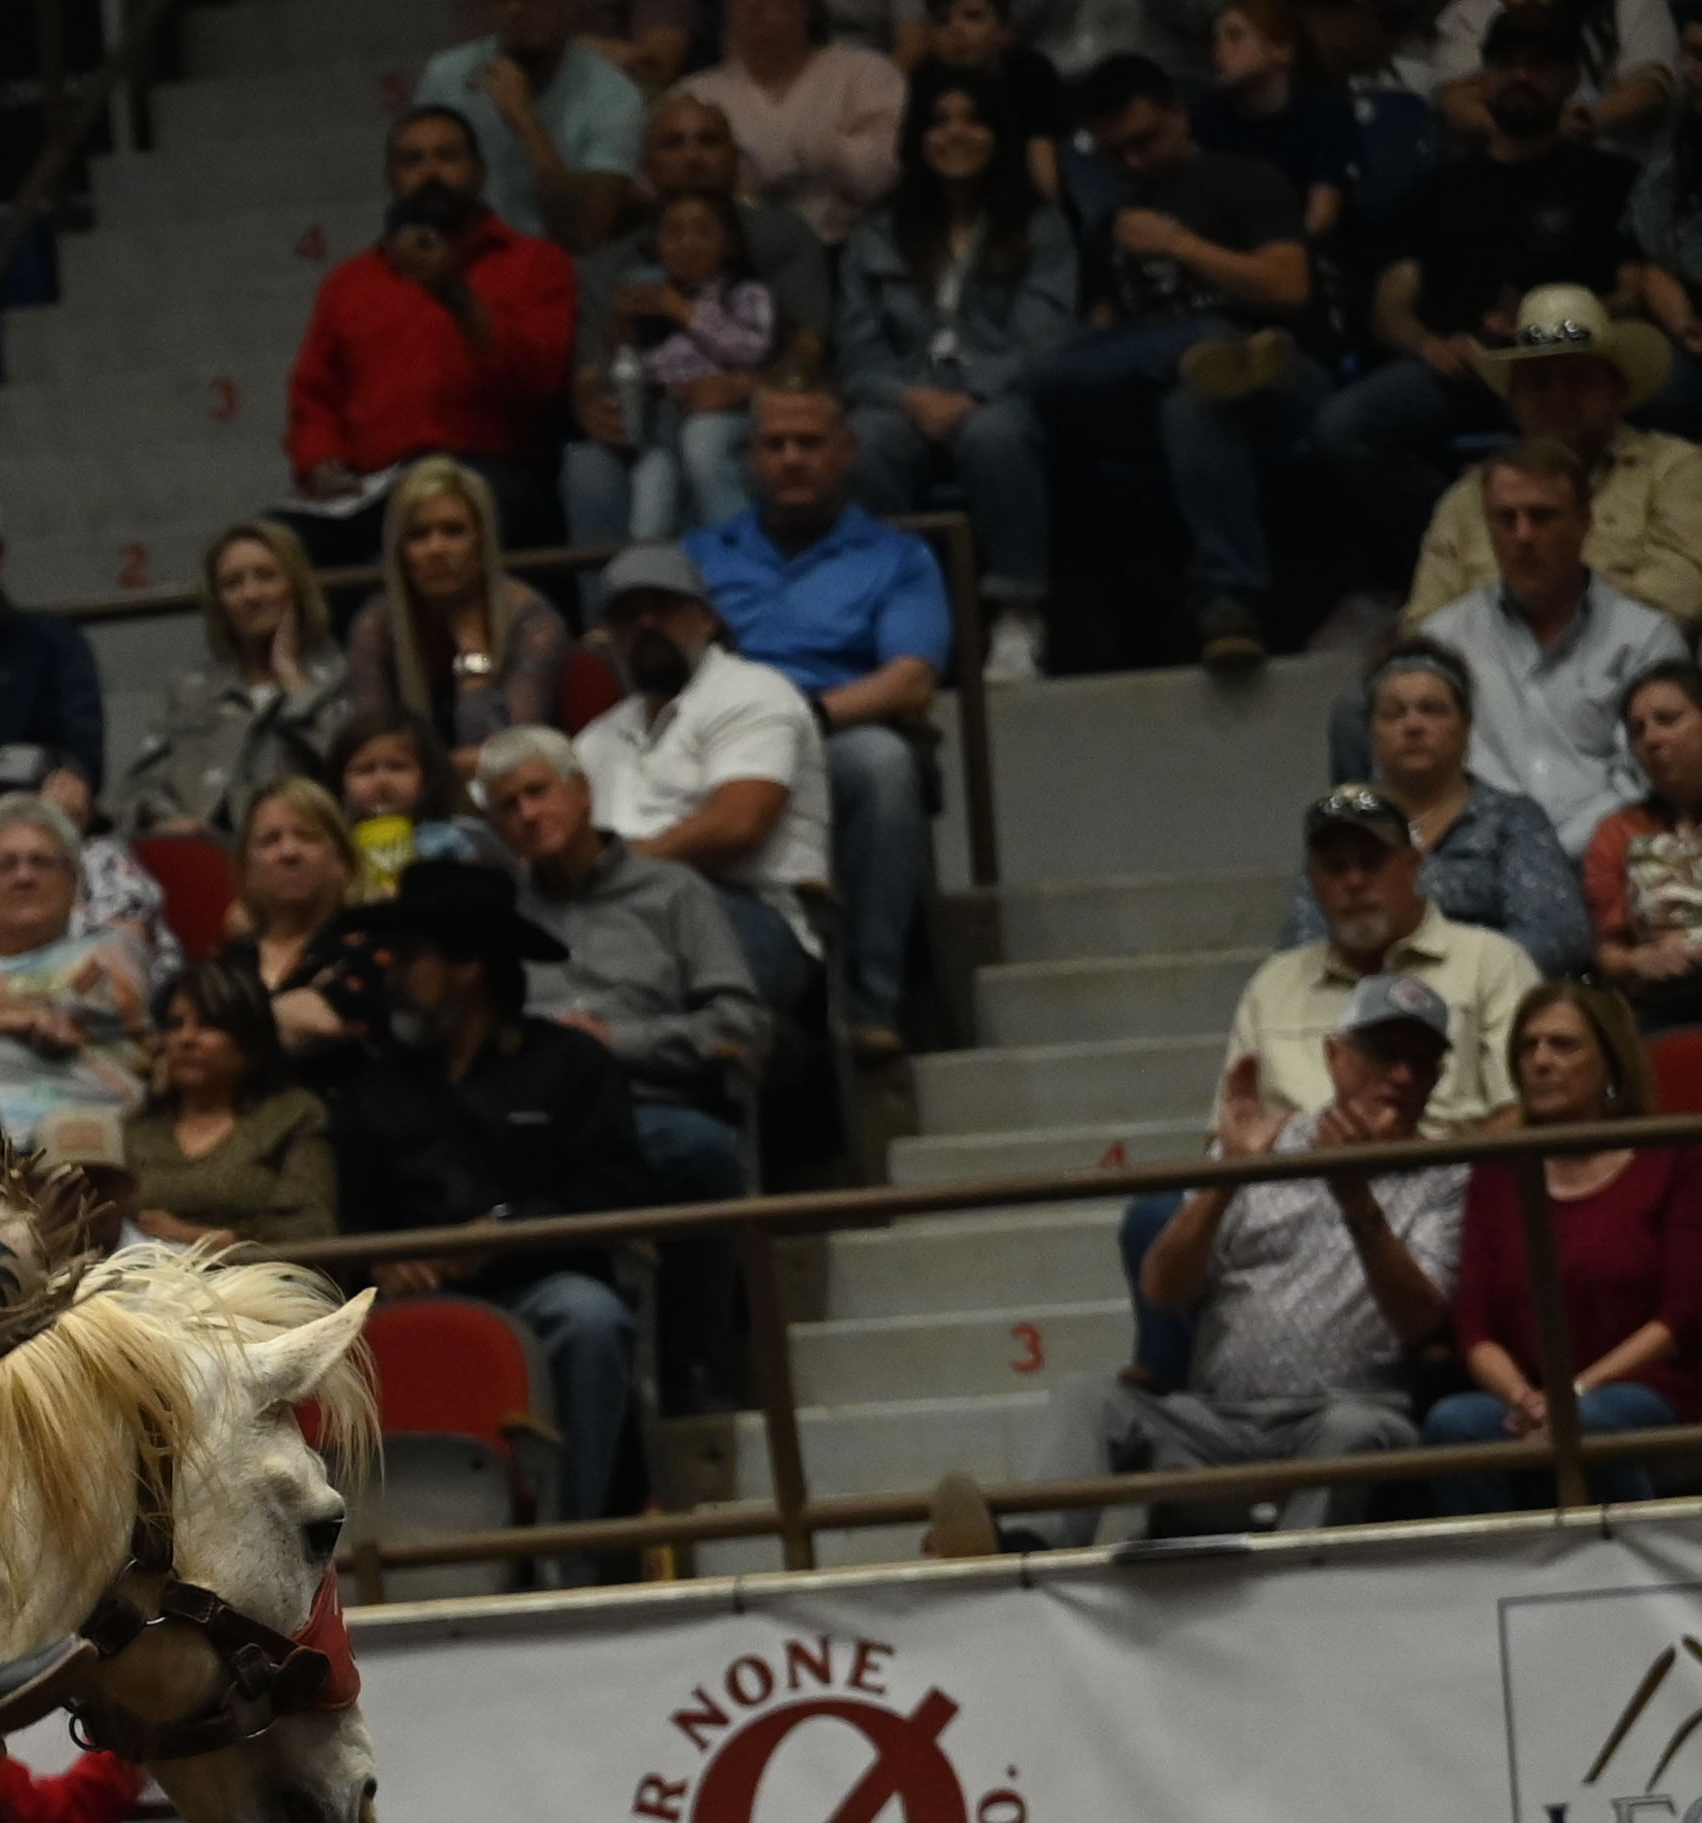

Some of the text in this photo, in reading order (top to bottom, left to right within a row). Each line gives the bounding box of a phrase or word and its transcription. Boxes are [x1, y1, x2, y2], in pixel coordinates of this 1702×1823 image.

[208, 376, 238, 423] 3
[118, 542, 151, 589] 2
[1010, 1323, 1046, 1374] 3
[669, 1633, 895, 1752] NONE
